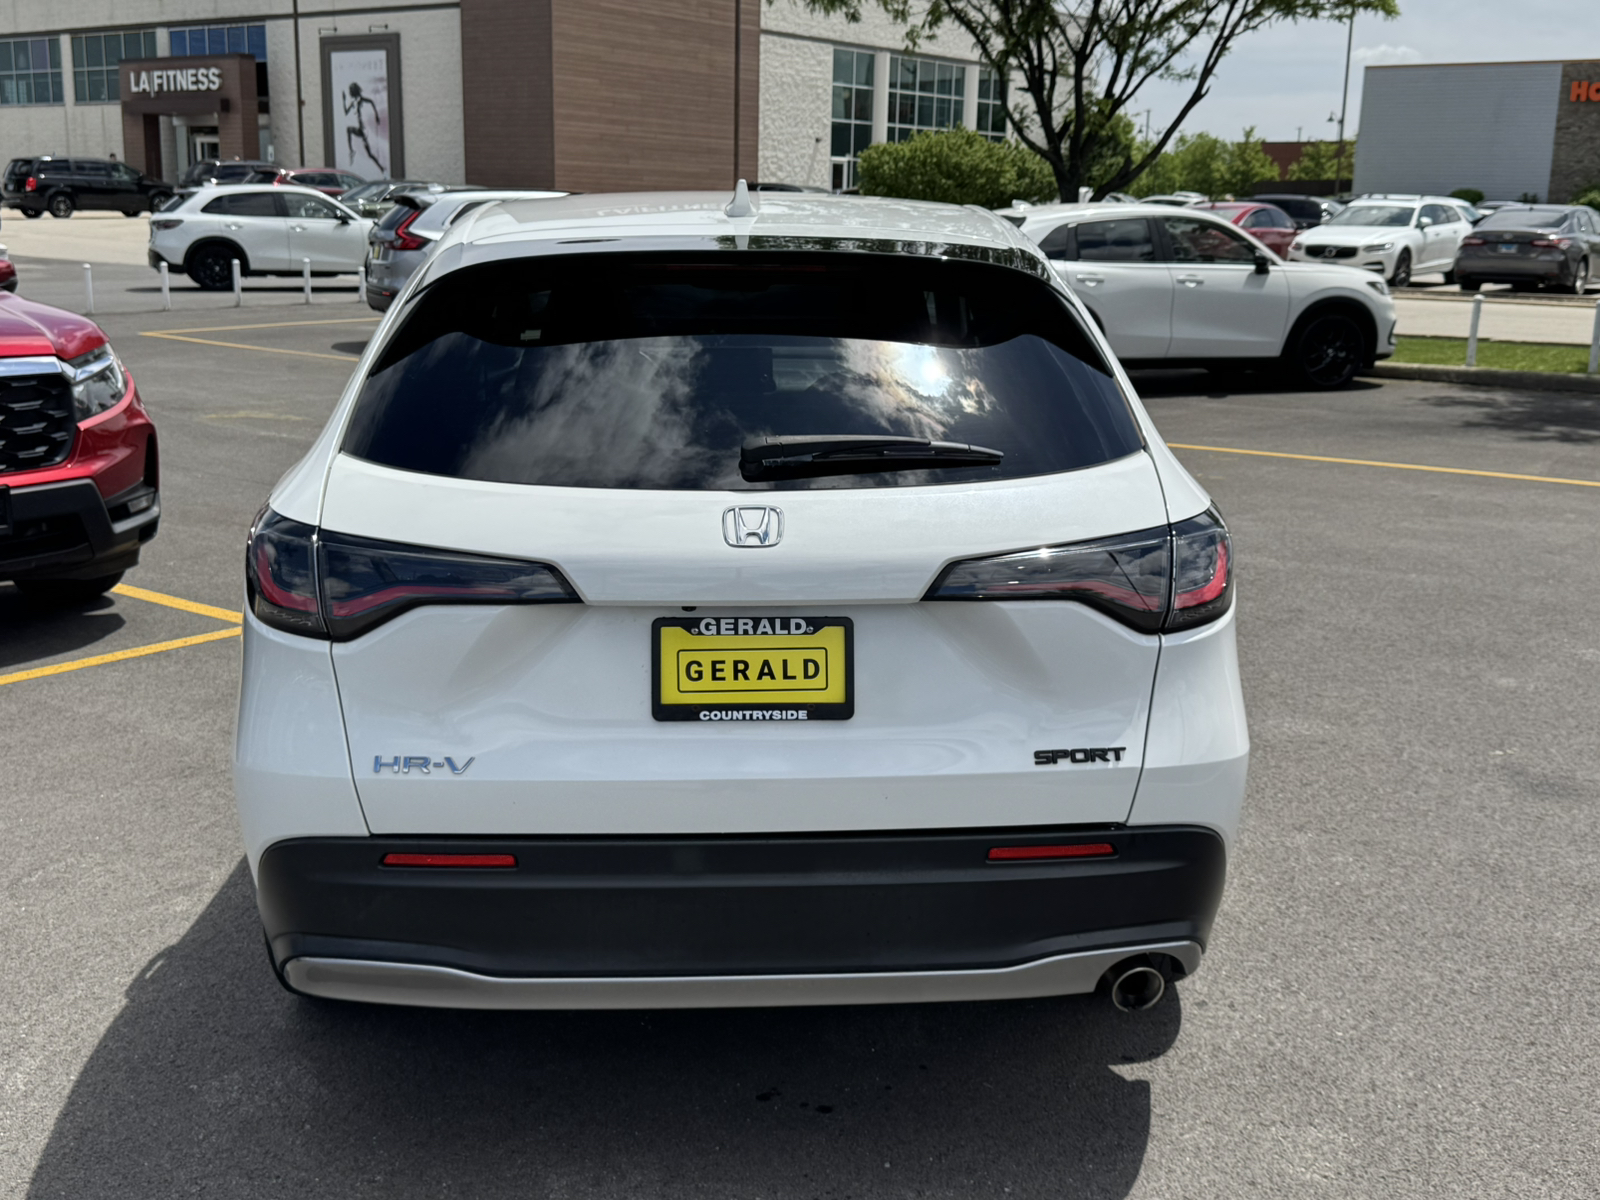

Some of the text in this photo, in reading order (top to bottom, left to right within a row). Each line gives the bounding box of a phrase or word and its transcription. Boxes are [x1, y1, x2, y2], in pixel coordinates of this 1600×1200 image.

[699, 617, 807, 636] GERALD
[685, 658, 820, 682] GERALD
[699, 710, 808, 721] COUNTRYSIDE
[373, 755, 475, 774] HR-V
[1033, 746, 1126, 766] SPORT
